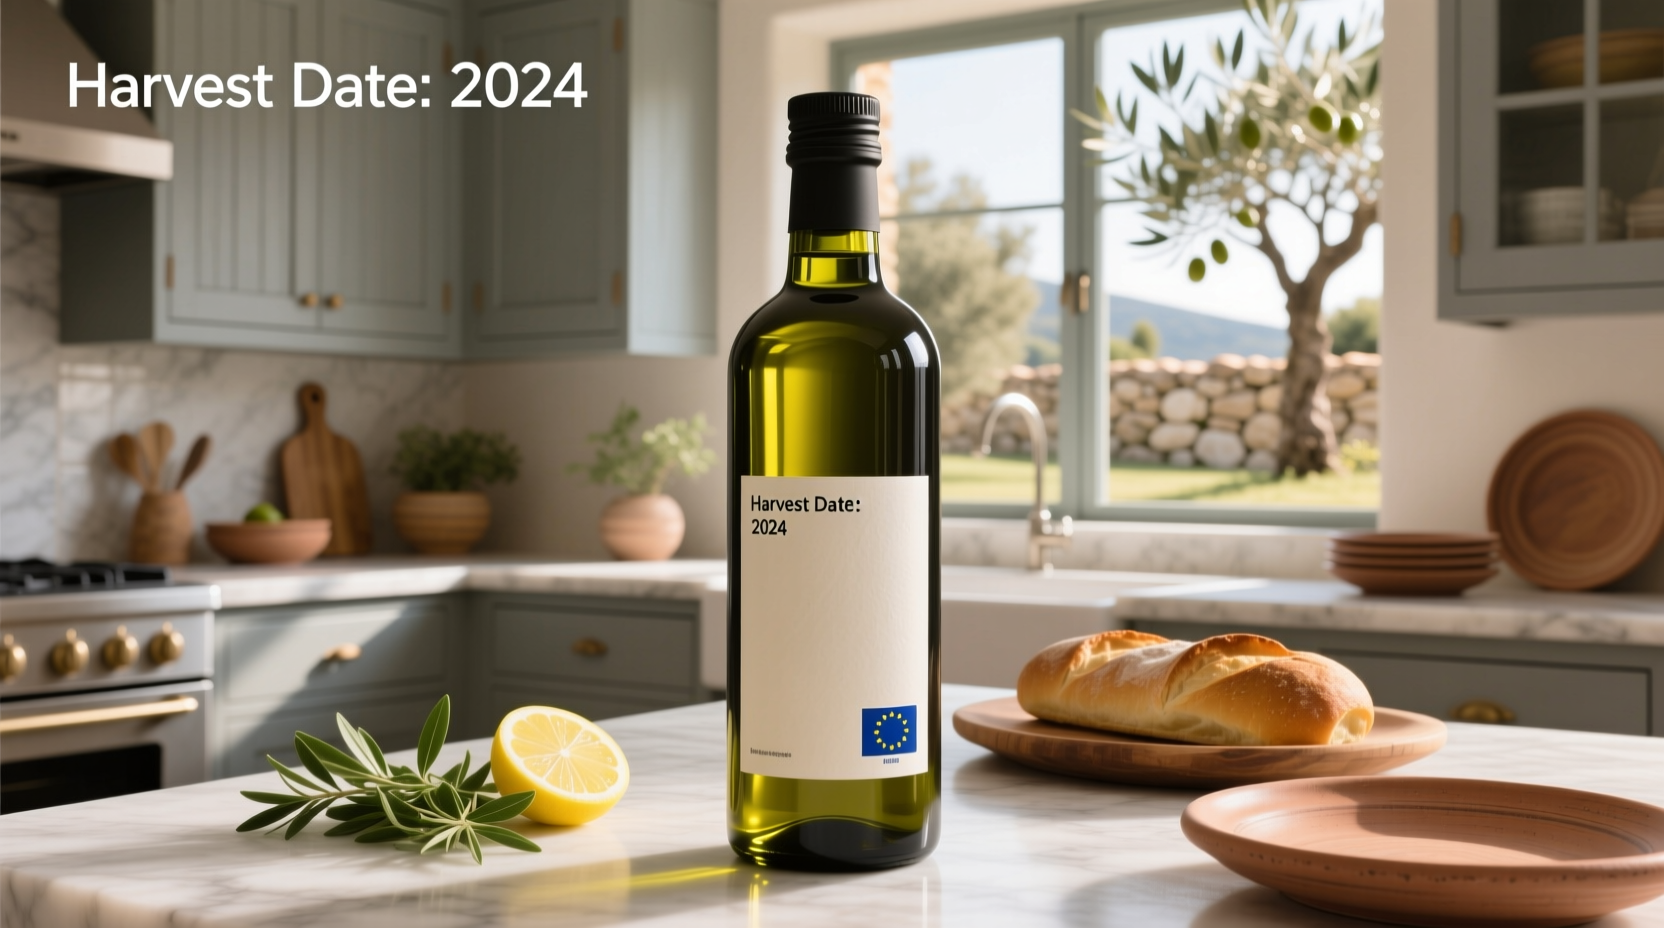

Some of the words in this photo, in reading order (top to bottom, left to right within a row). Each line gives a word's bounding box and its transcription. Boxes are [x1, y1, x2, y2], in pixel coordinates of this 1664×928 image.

[750, 494, 810, 513] Harvest
[814, 495, 861, 513] Date:
[751, 518, 787, 536] 2024
